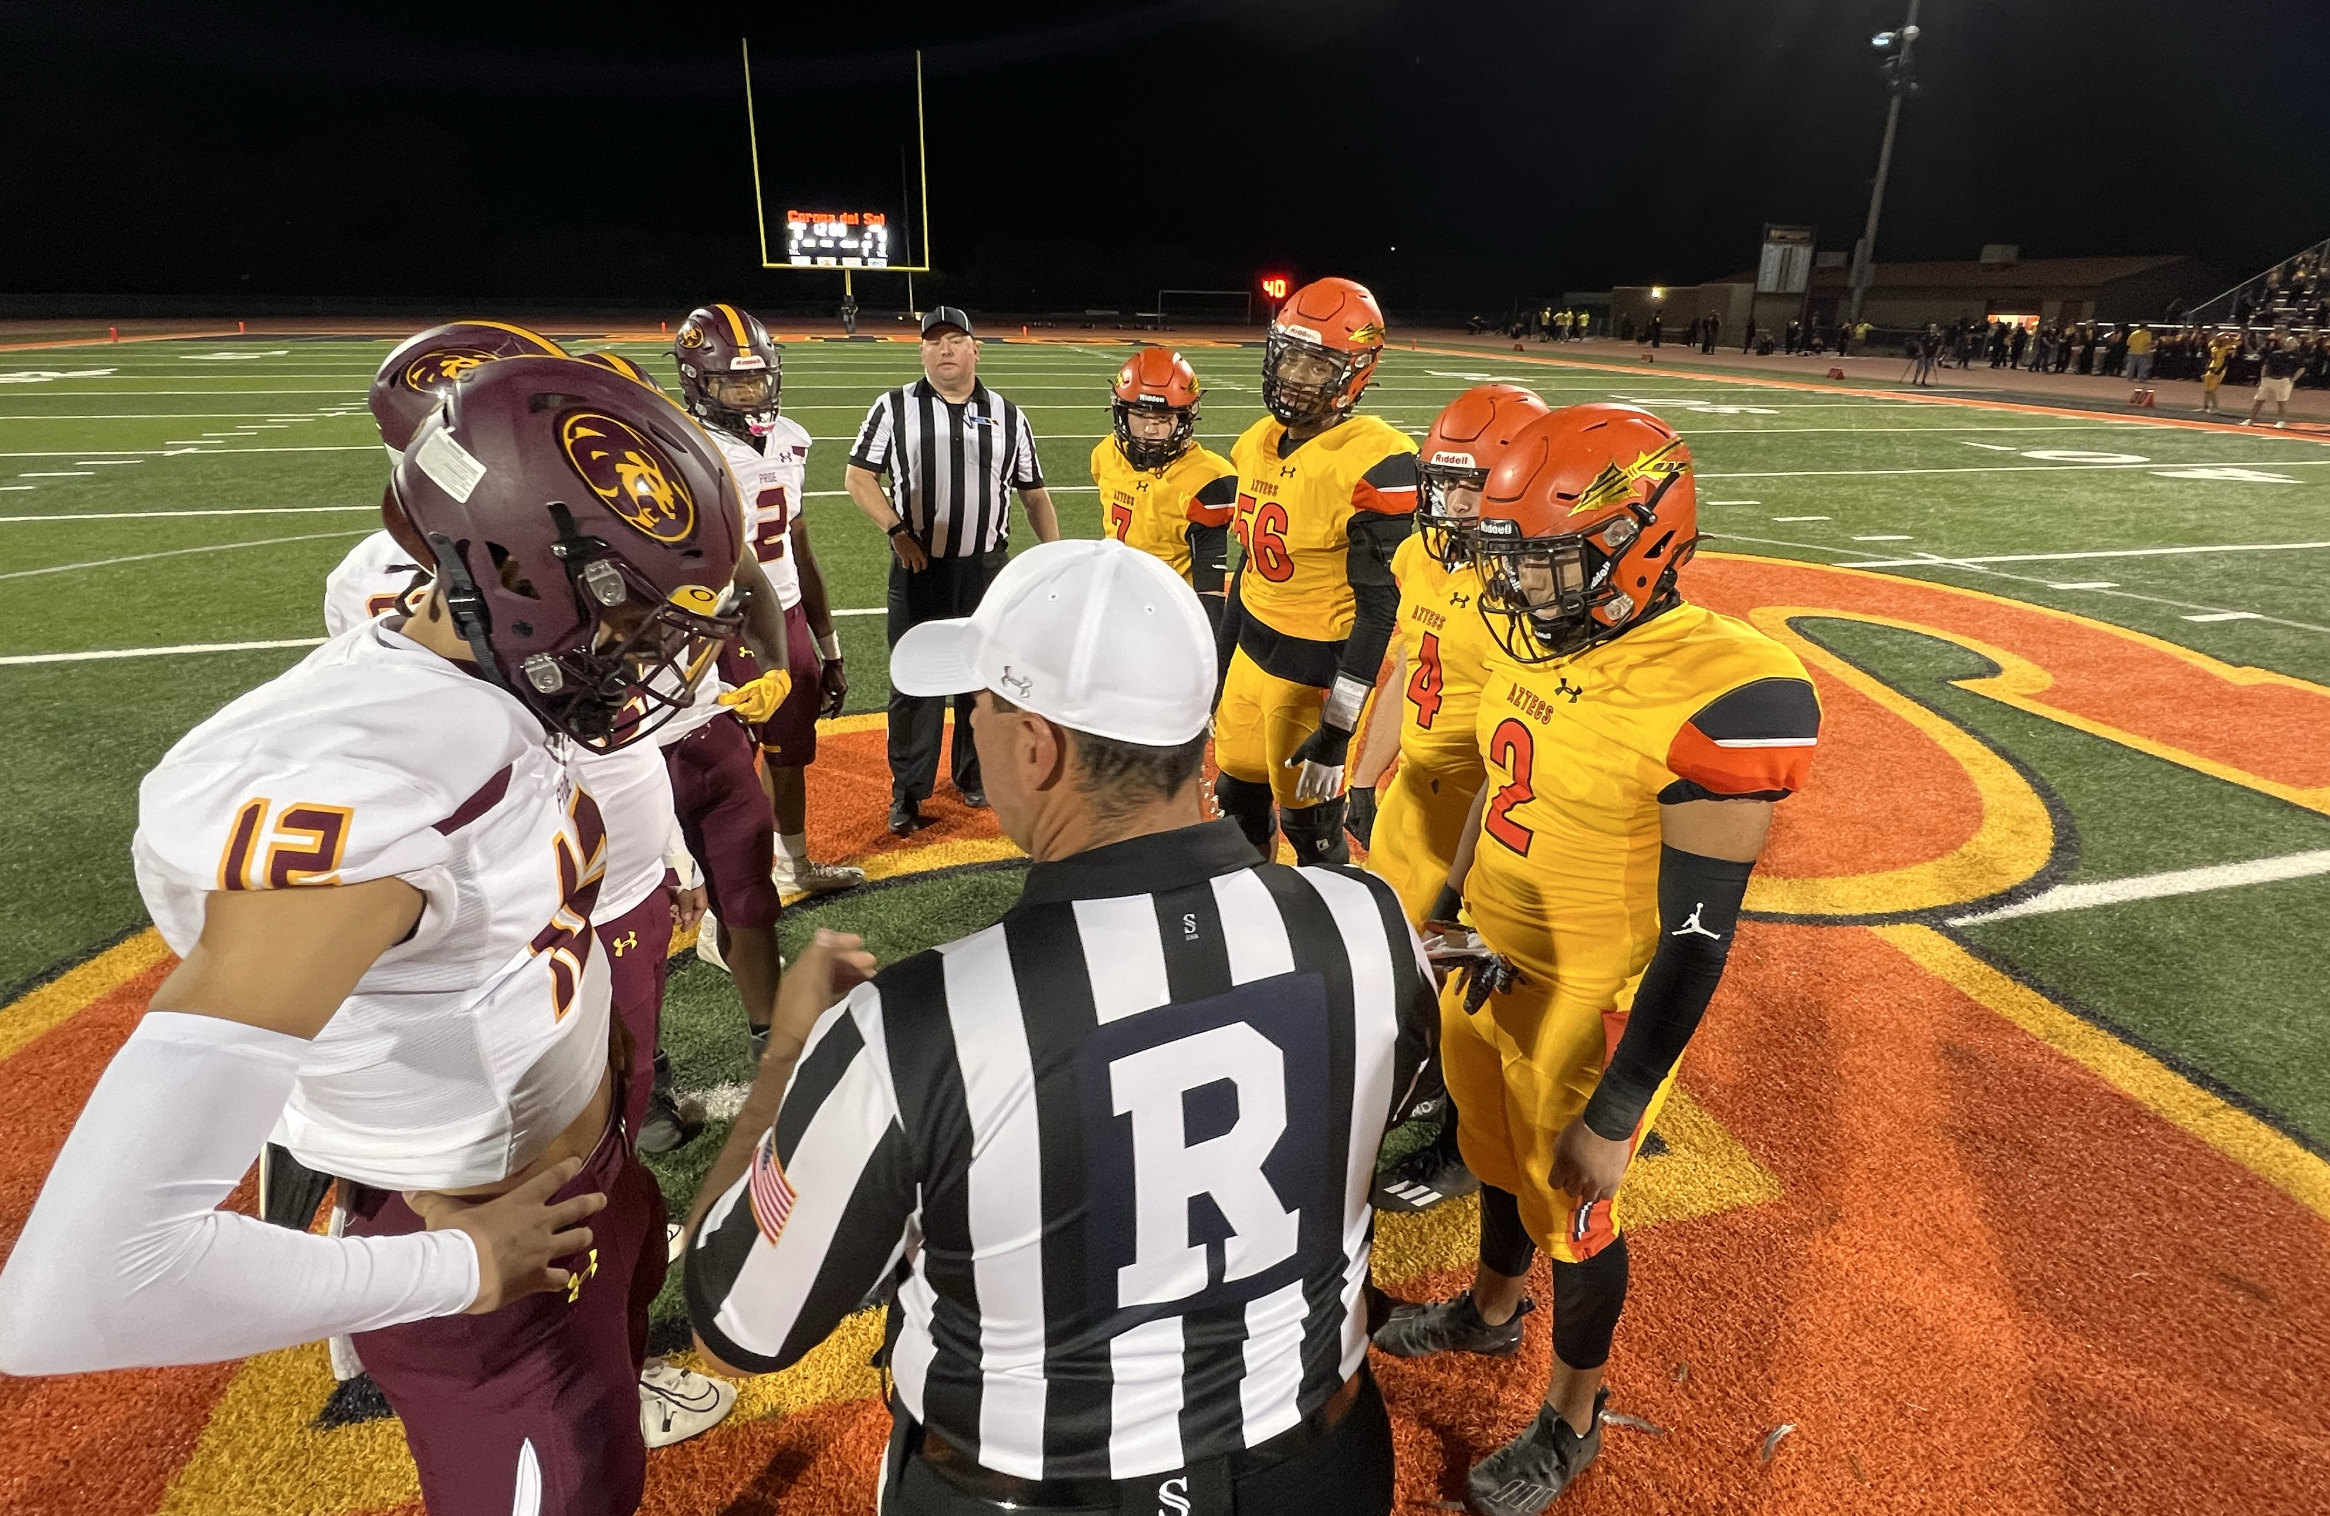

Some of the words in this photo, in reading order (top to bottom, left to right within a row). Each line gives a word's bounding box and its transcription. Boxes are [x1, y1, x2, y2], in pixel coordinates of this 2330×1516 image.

[787, 210, 835, 223] Corona
[840, 212, 859, 225] del
[863, 212, 885, 225] Sol
[1263, 279, 1286, 298] 40
[1435, 454, 1468, 465] Riddell
[759, 472, 777, 484] PRIDE
[1250, 478, 1279, 497] AZTECS
[1114, 489, 1135, 507] AZTECS
[755, 484, 789, 563] 2
[1112, 502, 1133, 544] 7
[1234, 492, 1295, 583] 56
[1480, 521, 1512, 535] Riddell
[1411, 604, 1446, 631] AZTECS
[1406, 630, 1443, 731] 4
[1506, 682, 1554, 725] AZTECS
[1484, 717, 1536, 858] 2
[217, 797, 355, 891] 12
[1109, 1021, 1302, 1309] R
